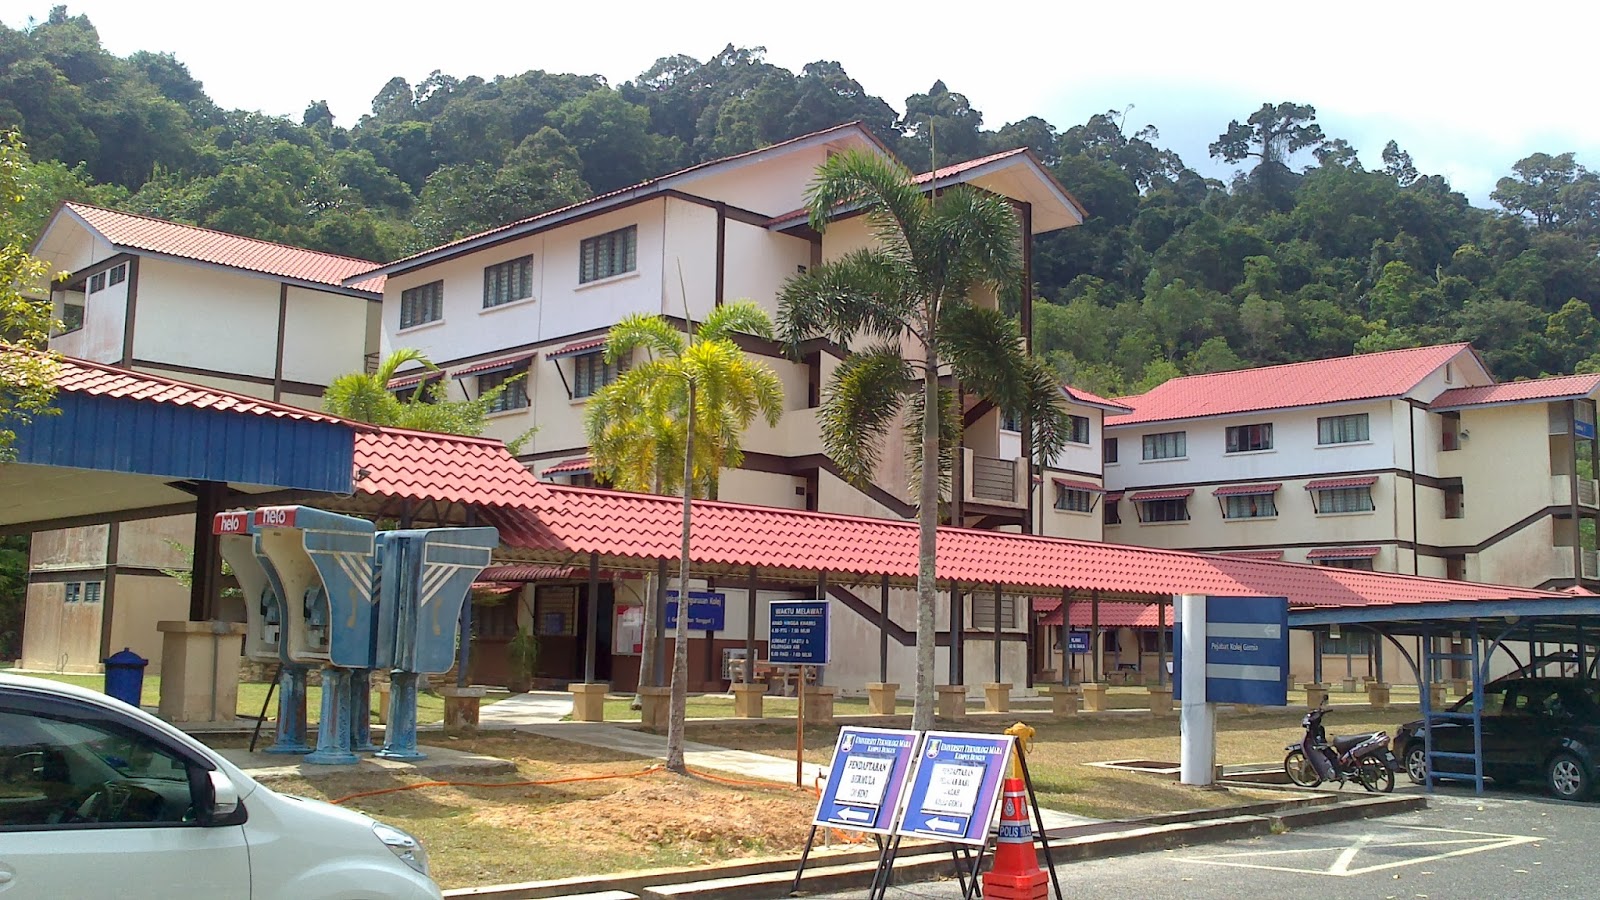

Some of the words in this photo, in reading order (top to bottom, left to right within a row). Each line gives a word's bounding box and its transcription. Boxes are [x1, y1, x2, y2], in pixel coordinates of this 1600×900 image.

[263, 509, 286, 524] helo
[221, 515, 239, 531] helo
[775, 607, 794, 615] WAKTU
[795, 607, 823, 615] MELAWAT
[1211, 642, 1229, 651] Pejabat
[1230, 643, 1242, 652] Kolej
[848, 760, 887, 772] PENDAFTARAN
[1000, 825, 1019, 838] POLIS
